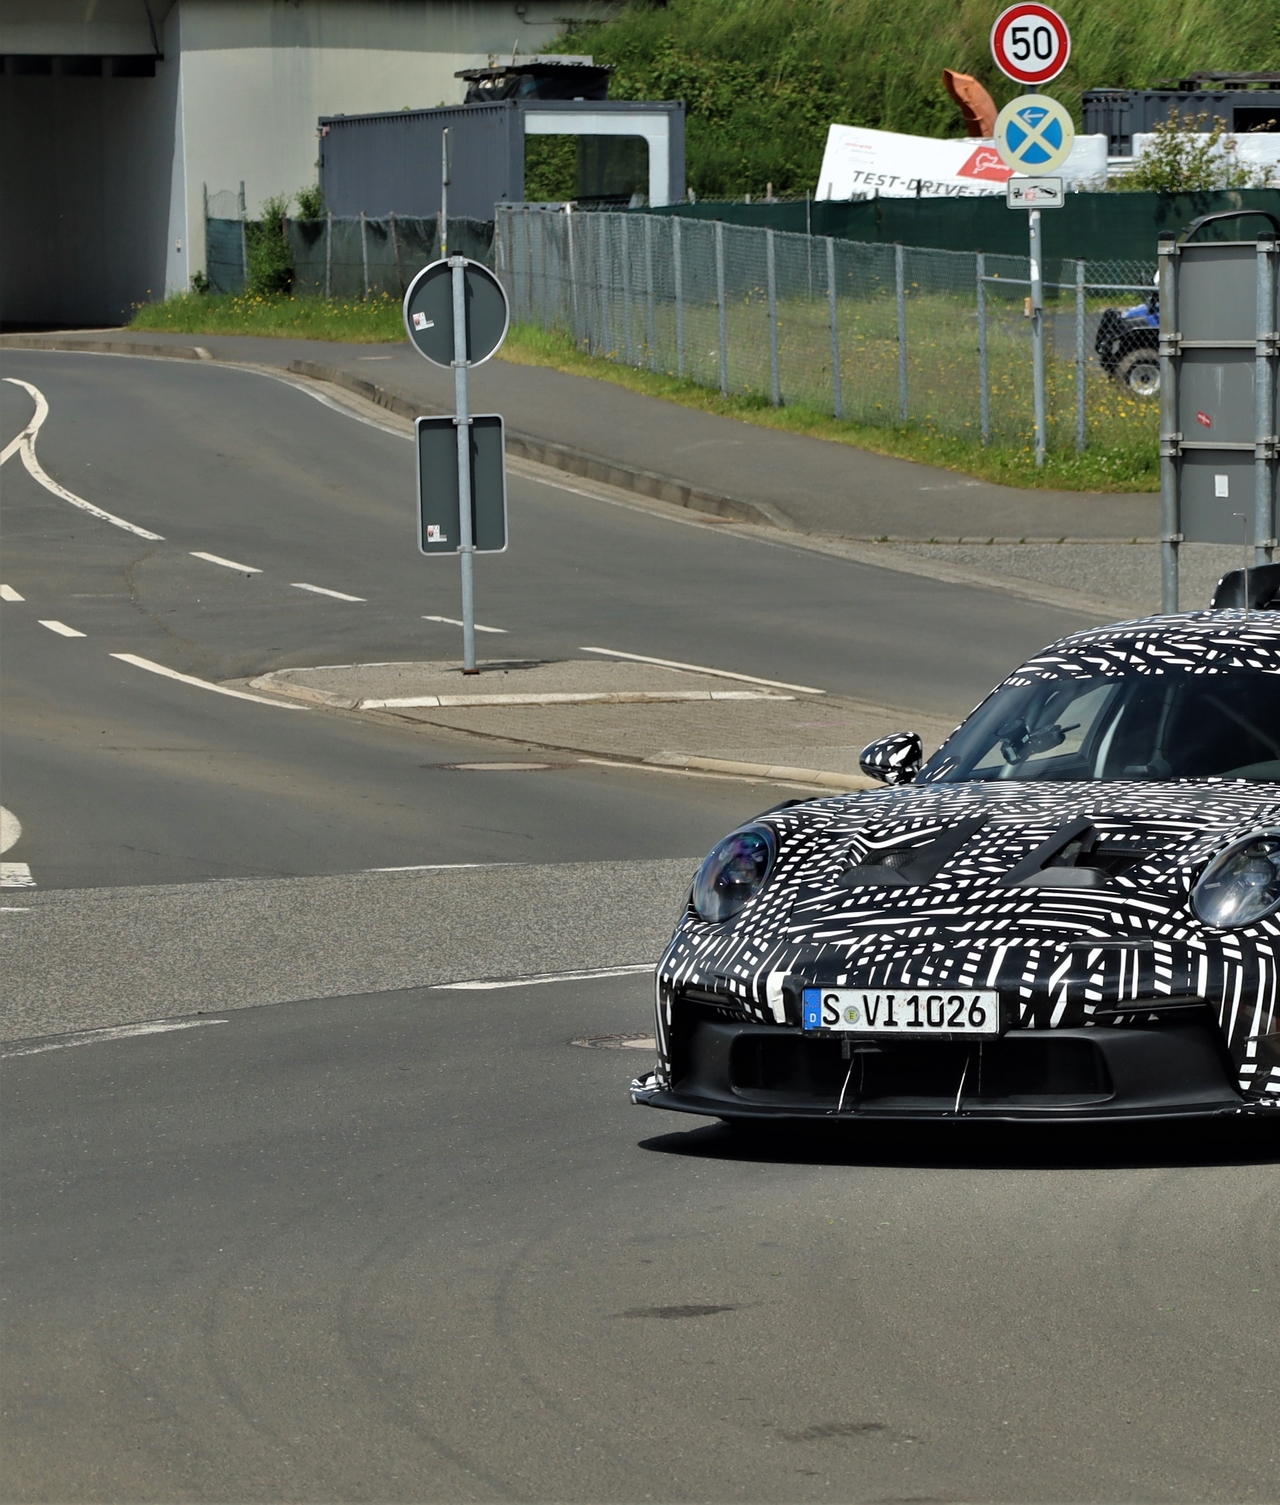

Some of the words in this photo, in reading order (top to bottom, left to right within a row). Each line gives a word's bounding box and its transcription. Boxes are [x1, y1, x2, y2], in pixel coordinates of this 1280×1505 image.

[1012, 26, 1052, 60] 50
[853, 170, 1007, 198] TEST-DRIVE-T
[809, 1013, 817, 1023] D
[822, 993, 840, 1025] S
[906, 995, 987, 1027] 1026
